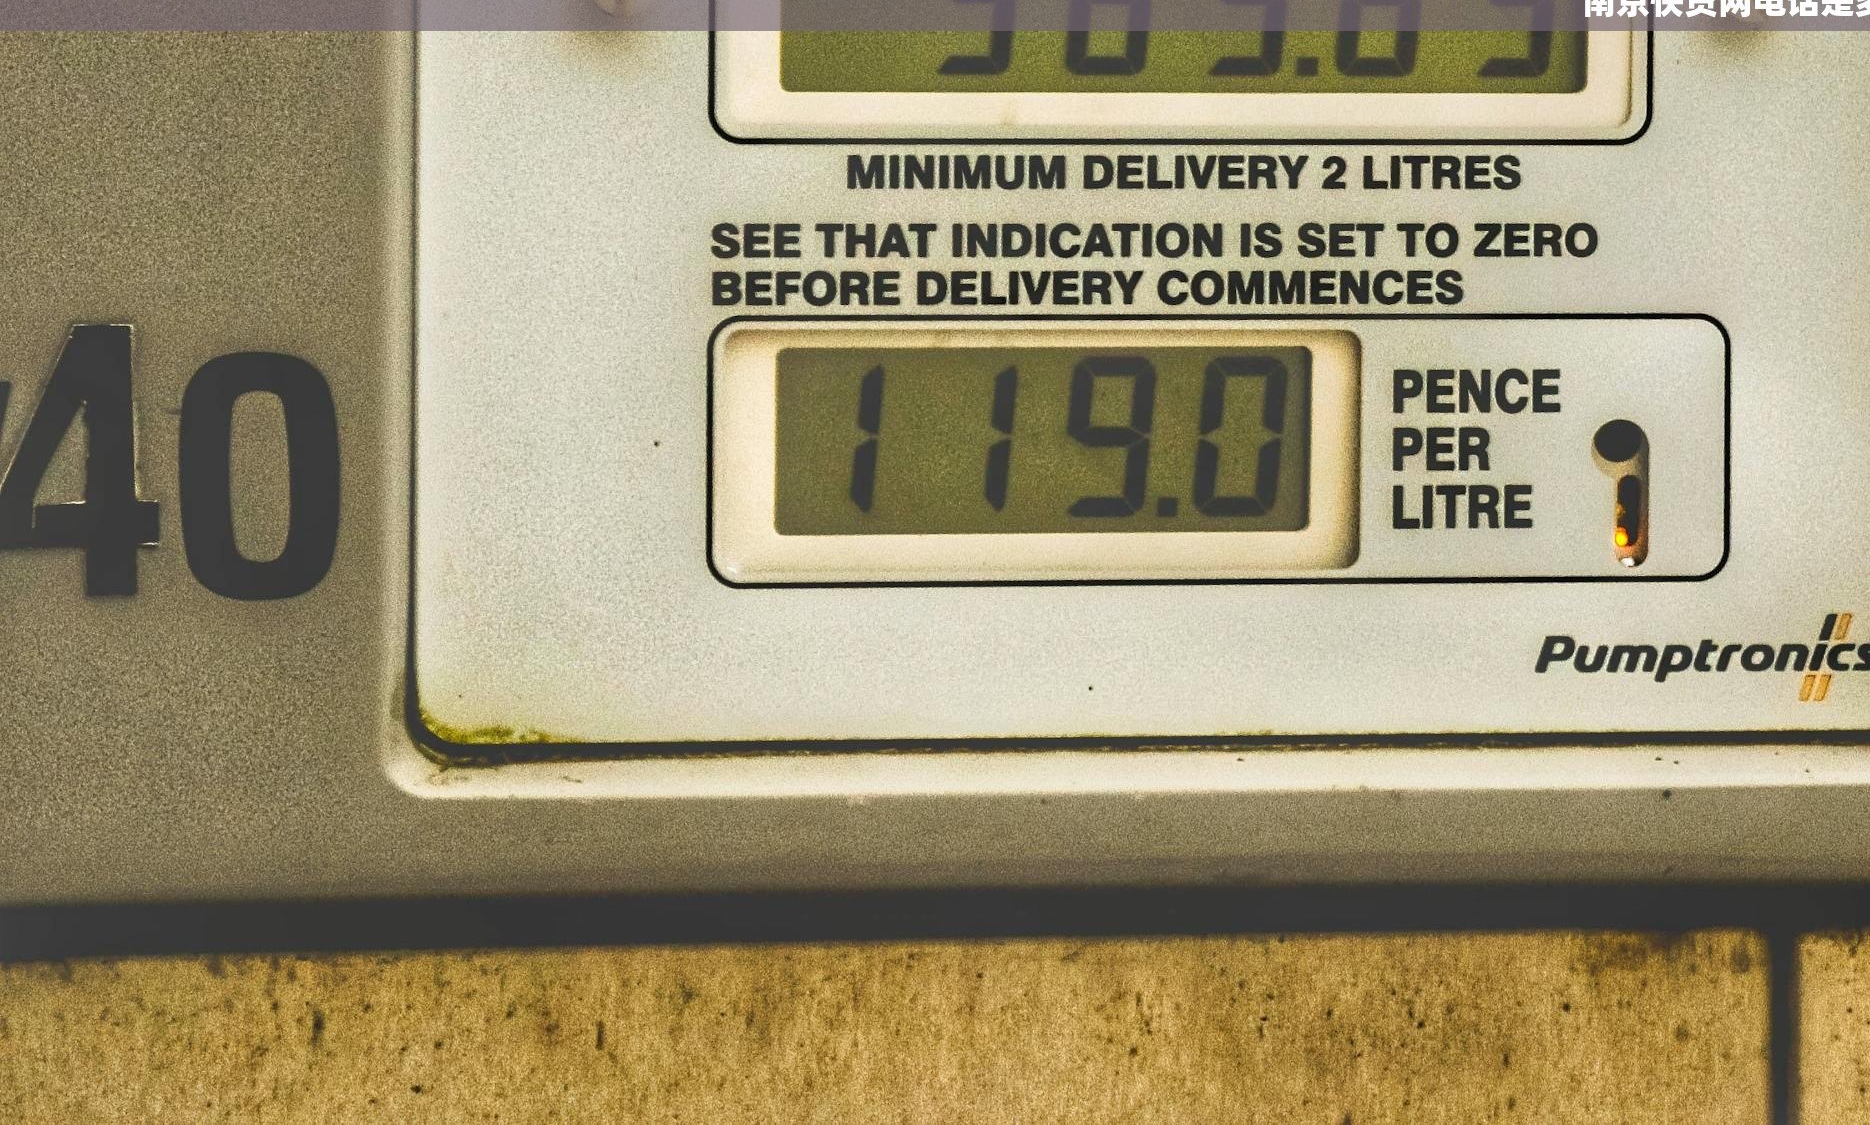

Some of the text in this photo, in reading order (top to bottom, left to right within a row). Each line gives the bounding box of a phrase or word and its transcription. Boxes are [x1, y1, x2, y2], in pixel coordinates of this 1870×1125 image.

[846, 154, 1522, 191] MINIMUM DELIVERY 2 LITRES
[710, 222, 1598, 259] SEE THAT INDICATION IS SET TO ZERO
[711, 269, 1464, 306] BEFORE DELIVERY COMMENCES
[1392, 369, 1562, 414] PENCE
[849, 355, 1288, 518] 119.0
[1392, 429, 1491, 472] PER
[0, 324, 341, 601] 40
[1392, 486, 1534, 530] LITRE
